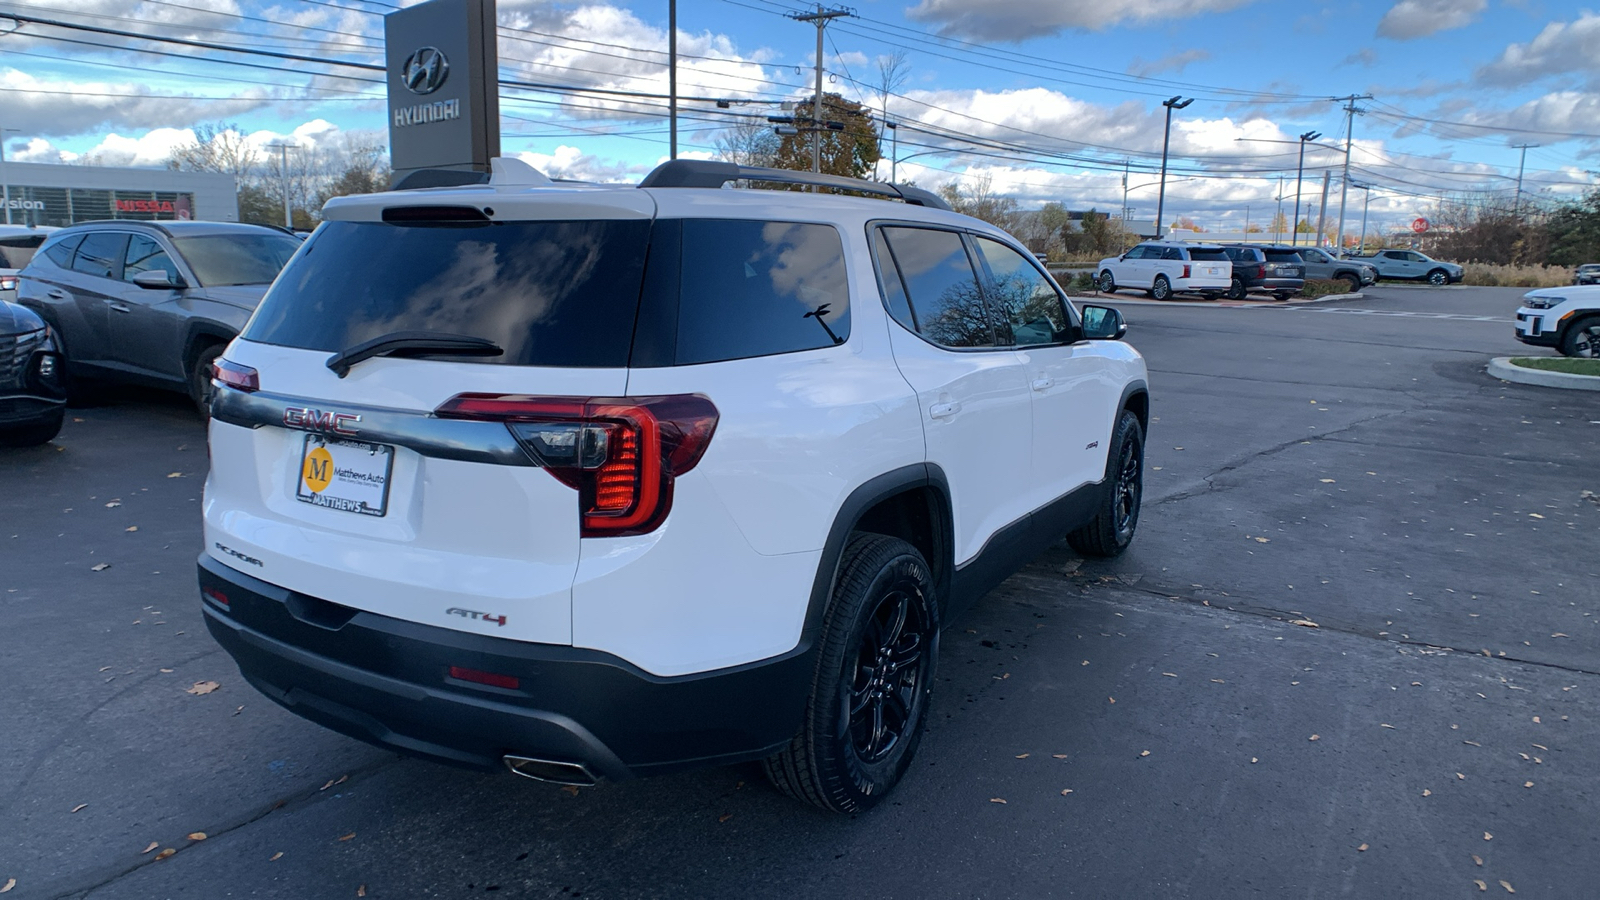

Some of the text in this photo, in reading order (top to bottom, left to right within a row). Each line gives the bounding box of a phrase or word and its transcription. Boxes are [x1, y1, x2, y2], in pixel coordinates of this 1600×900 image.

[394, 98, 460, 127] HYUNDAI
[115, 199, 176, 212] NISSA
[283, 407, 362, 436] GMC
[307, 457, 330, 483] M
[333, 466, 367, 481] Matthews
[367, 473, 385, 484] Auto
[312, 495, 362, 513] MATTHEWS
[215, 542, 264, 568] ACADIA
[446, 607, 507, 627] AT4
